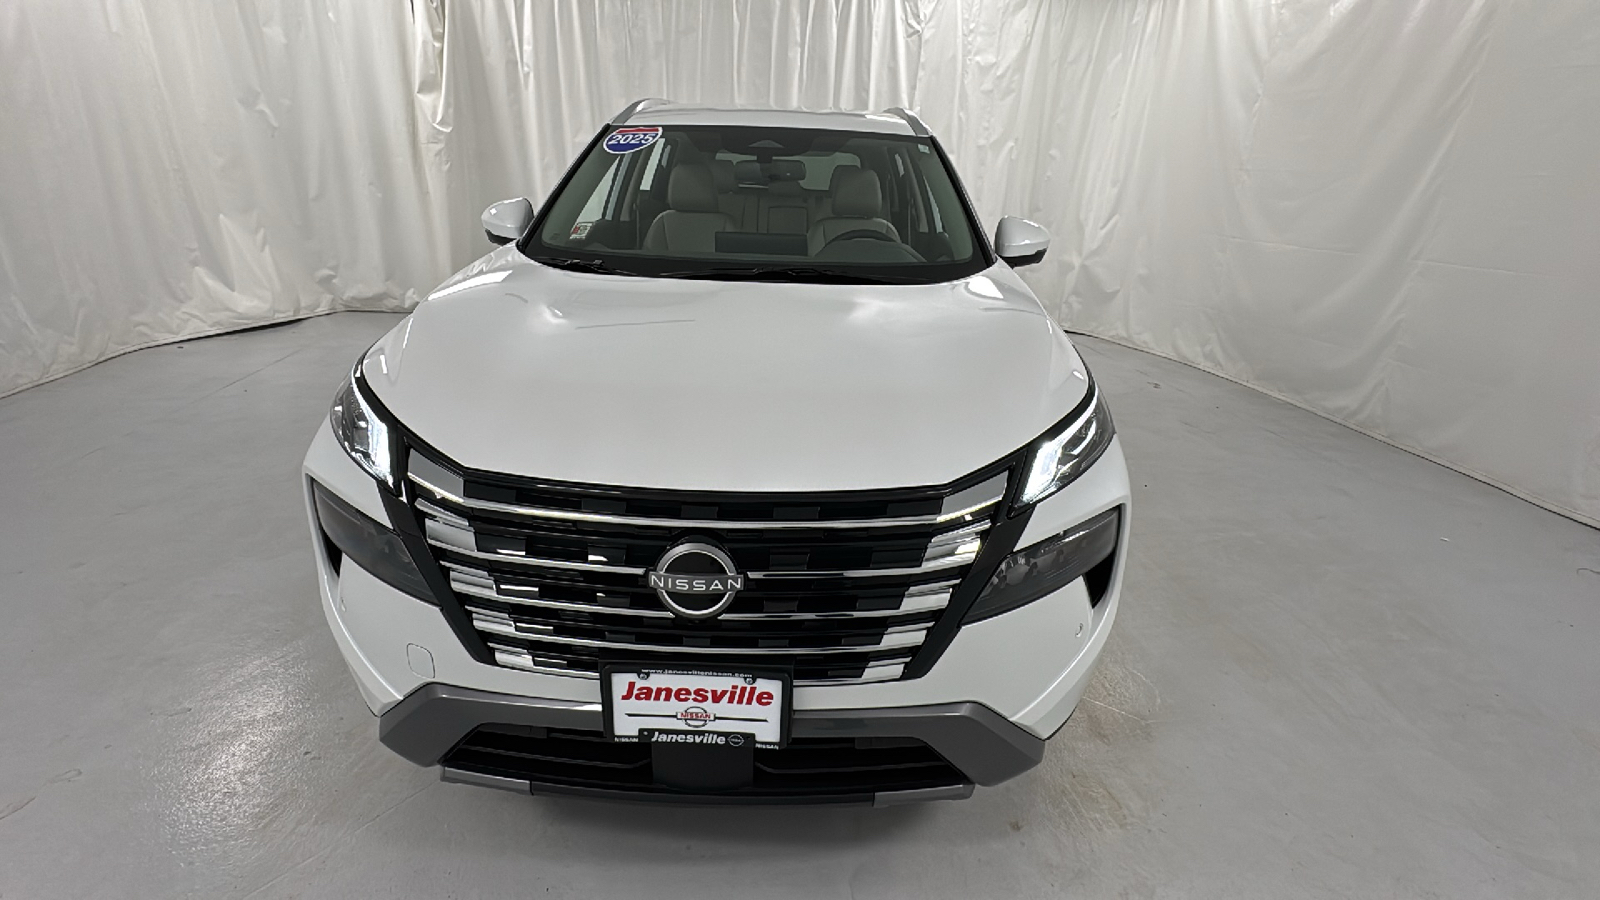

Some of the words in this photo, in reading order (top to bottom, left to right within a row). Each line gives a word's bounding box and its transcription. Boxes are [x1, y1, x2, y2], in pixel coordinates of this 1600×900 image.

[607, 134, 656, 145] 2025
[651, 574, 741, 591] NISSAN
[621, 681, 774, 706] Janesville
[651, 731, 726, 745] Janesville
